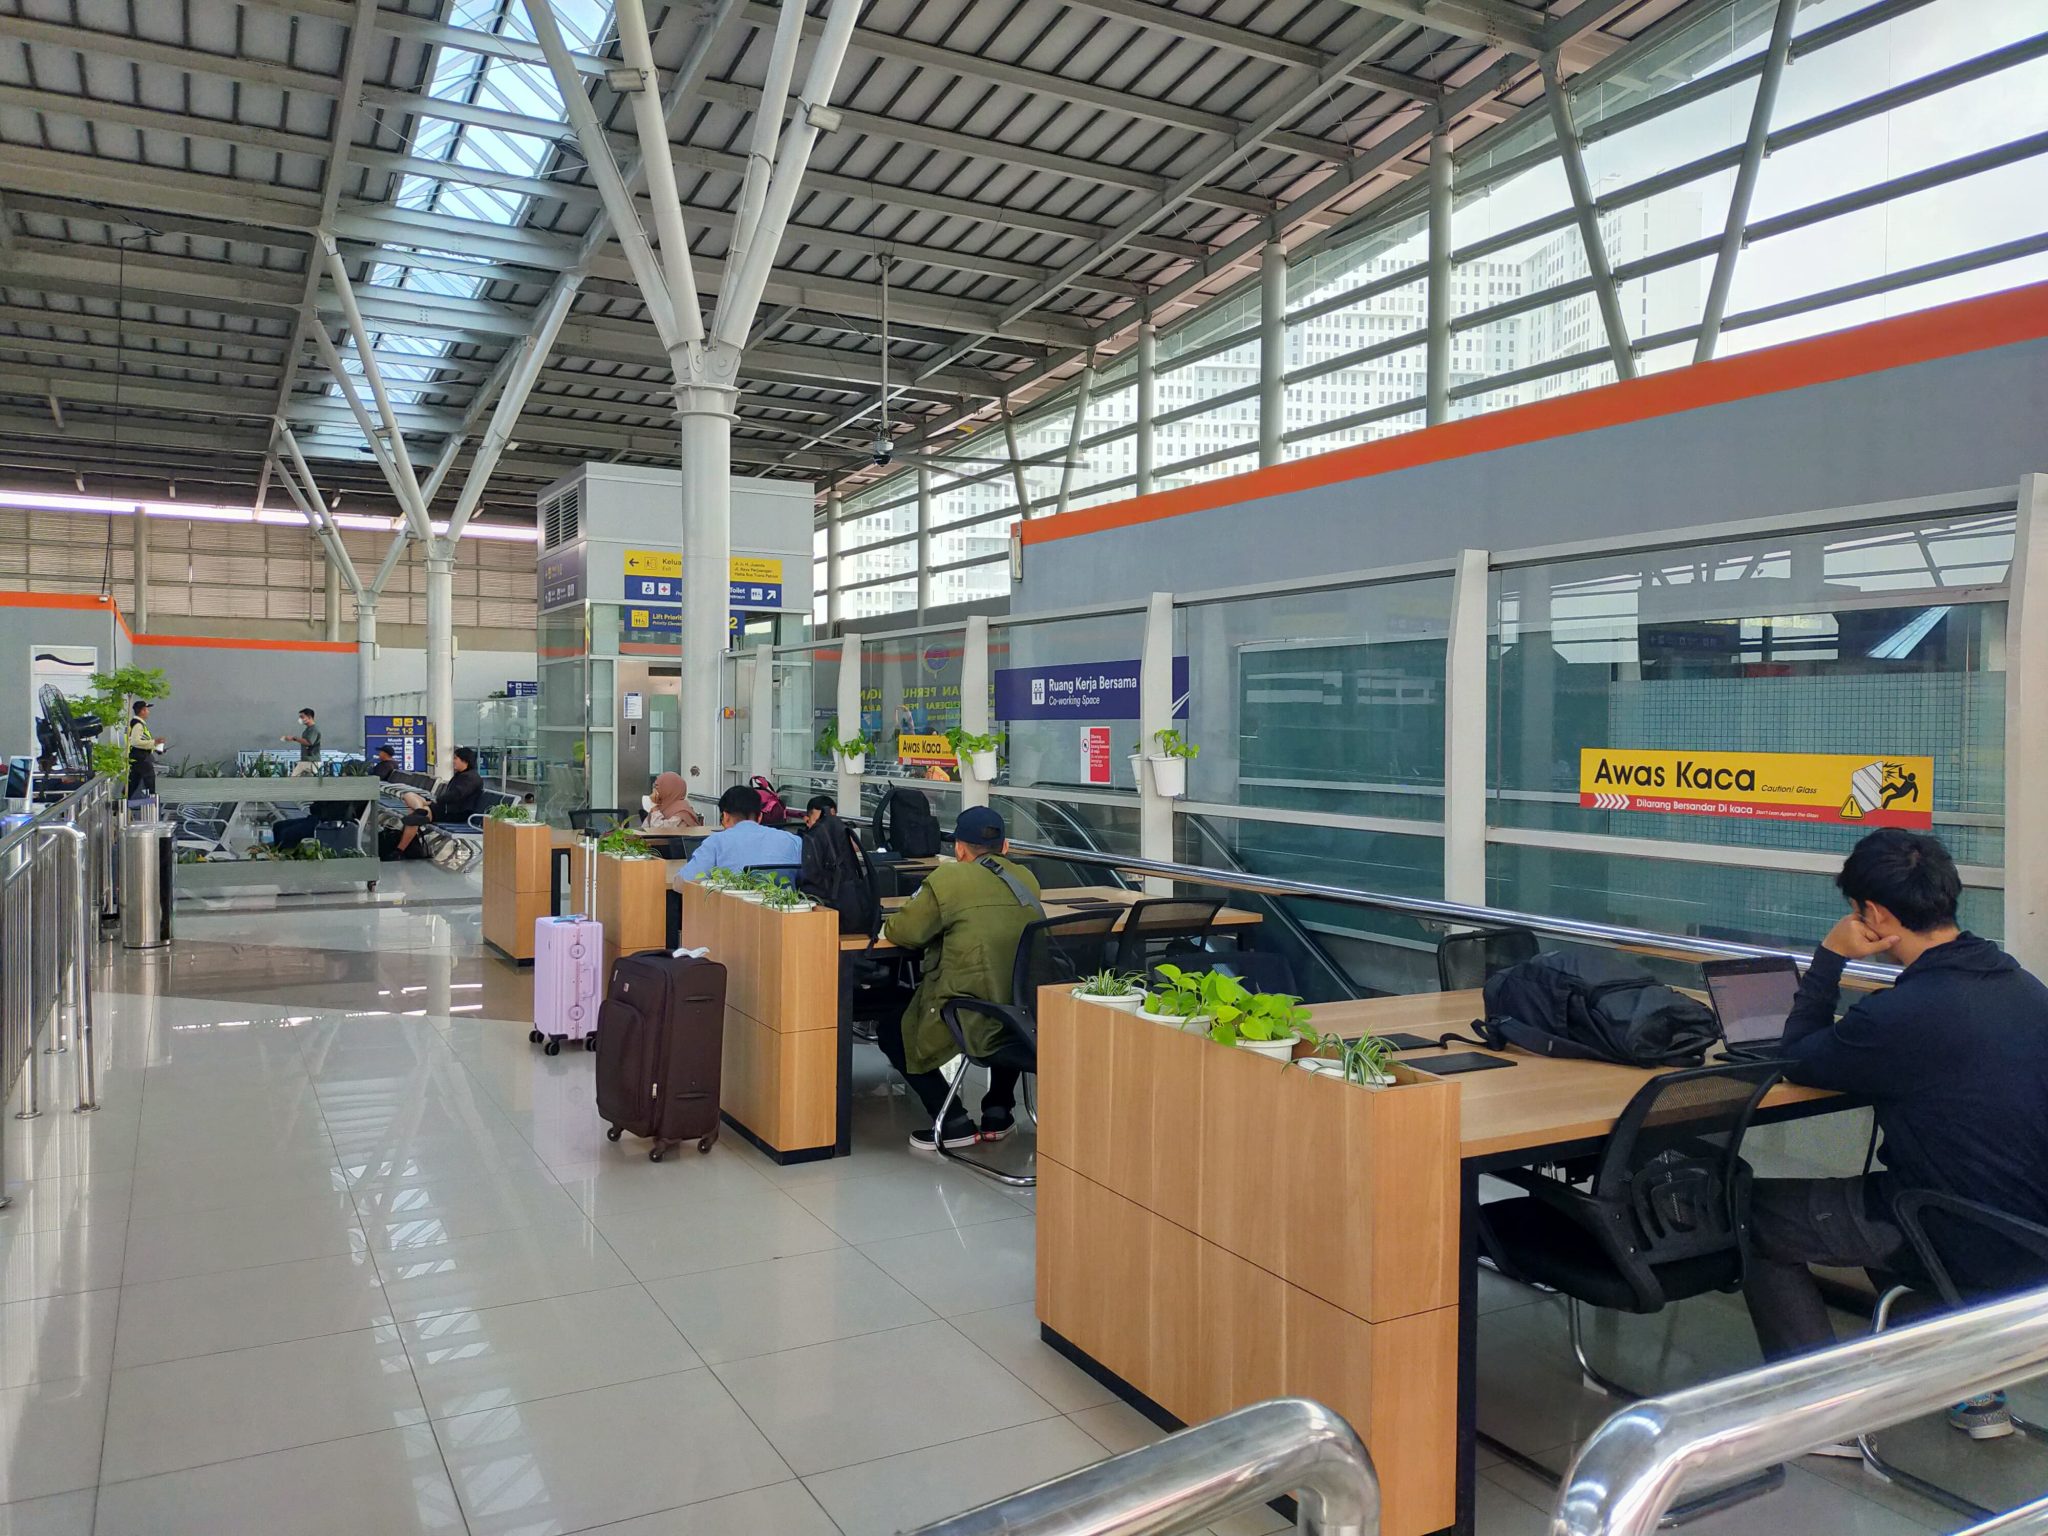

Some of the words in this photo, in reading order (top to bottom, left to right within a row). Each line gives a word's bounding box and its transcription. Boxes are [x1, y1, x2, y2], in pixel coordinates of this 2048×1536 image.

[662, 558, 682, 566] Kelua
[1049, 679, 1074, 694] Ruang
[1075, 676, 1097, 693] Kerja
[1099, 675, 1137, 690] Bersama
[1048, 696, 1080, 708] Co-working
[1081, 694, 1100, 706] Space
[903, 740, 920, 753] Awas
[922, 740, 941, 754] Kaca
[1594, 758, 1665, 787] Awas
[1676, 761, 1755, 791] Kaca
[1761, 784, 1795, 793] Caution!
[1796, 786, 1817, 794] Glass
[1636, 798, 1671, 811] Dilarang
[1673, 801, 1716, 812] Bersandar
[1718, 803, 1727, 813] Di
[1729, 803, 1753, 814] kaca
